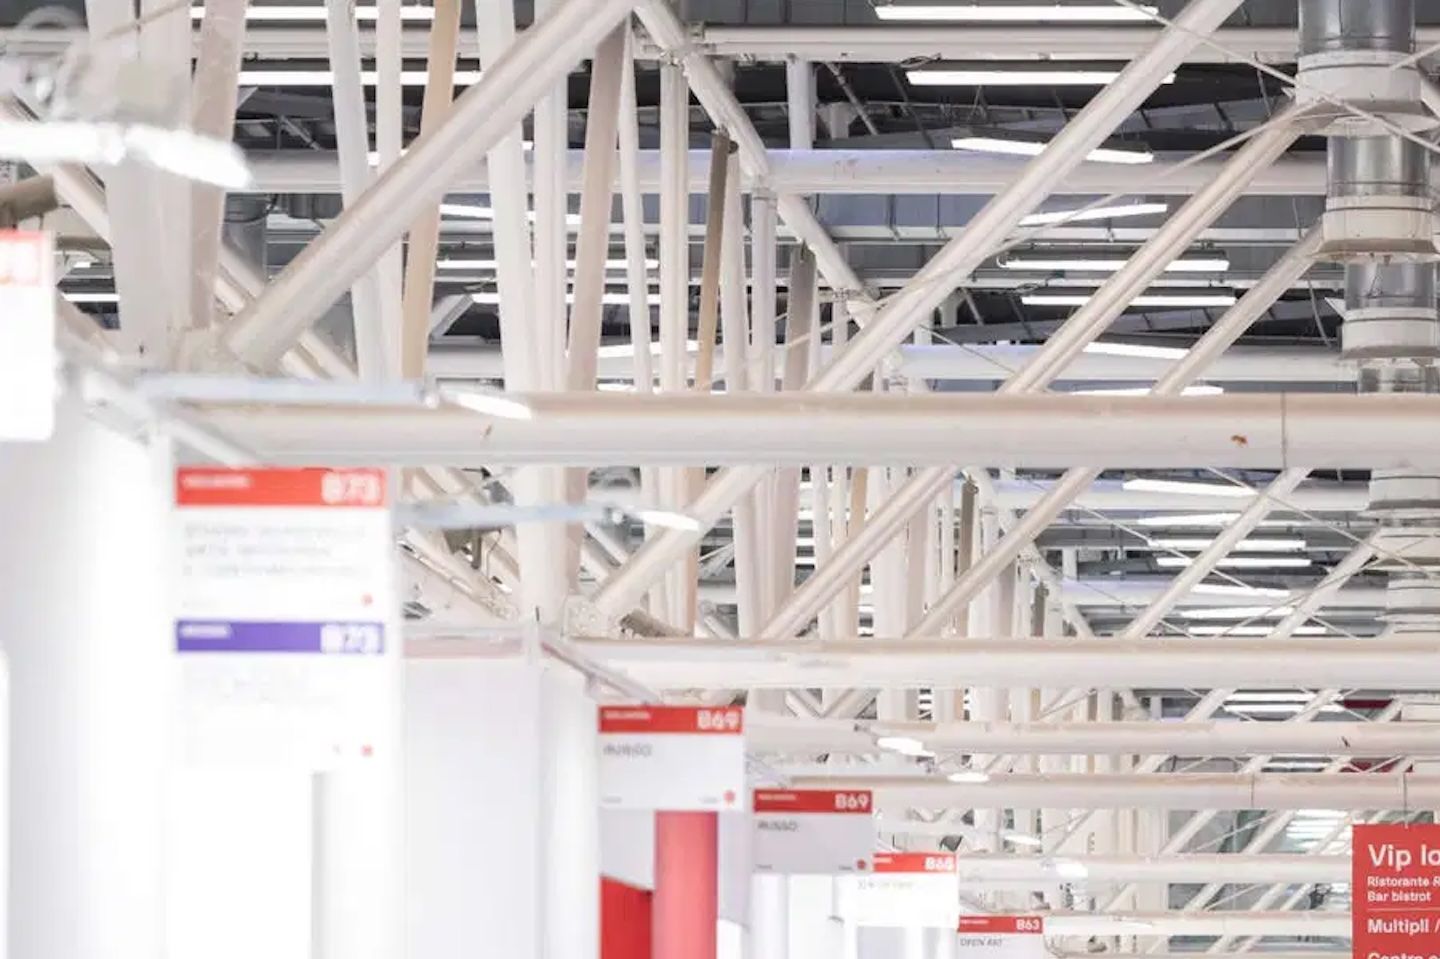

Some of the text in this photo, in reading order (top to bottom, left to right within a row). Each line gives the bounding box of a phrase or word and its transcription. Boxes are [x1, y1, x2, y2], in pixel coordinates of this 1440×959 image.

[834, 793, 869, 809] B69
[1368, 843, 1412, 871] Vip
[1367, 875, 1430, 887] Ristorante
[1367, 890, 1432, 902] Bar bistrot
[1016, 918, 1040, 930] B63
[1367, 918, 1429, 936] Multipli
